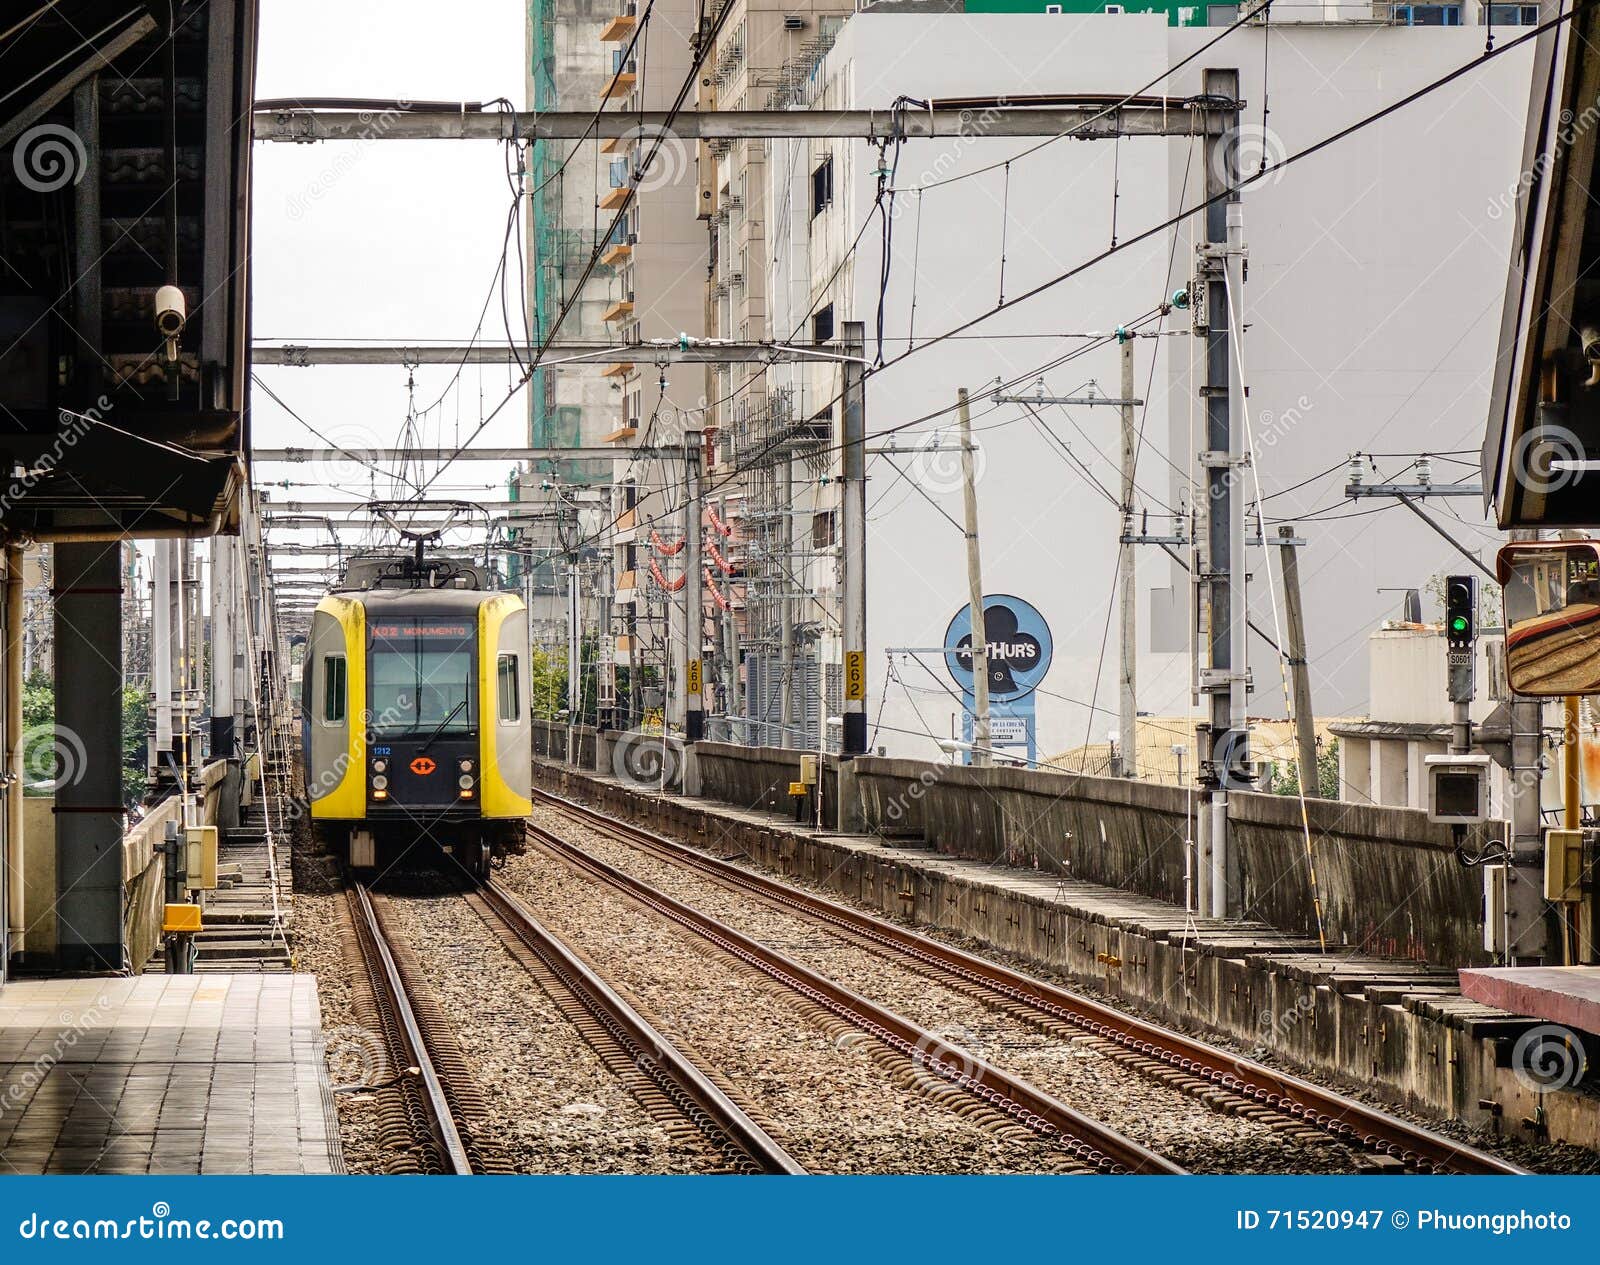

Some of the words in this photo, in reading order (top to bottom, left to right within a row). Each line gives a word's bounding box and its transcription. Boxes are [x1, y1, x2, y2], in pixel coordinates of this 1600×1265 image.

[403, 627, 465, 635] MONUMENTO
[961, 641, 1036, 660] ATHUR'S
[850, 654, 859, 696] 262
[373, 747, 391, 755] 1212
